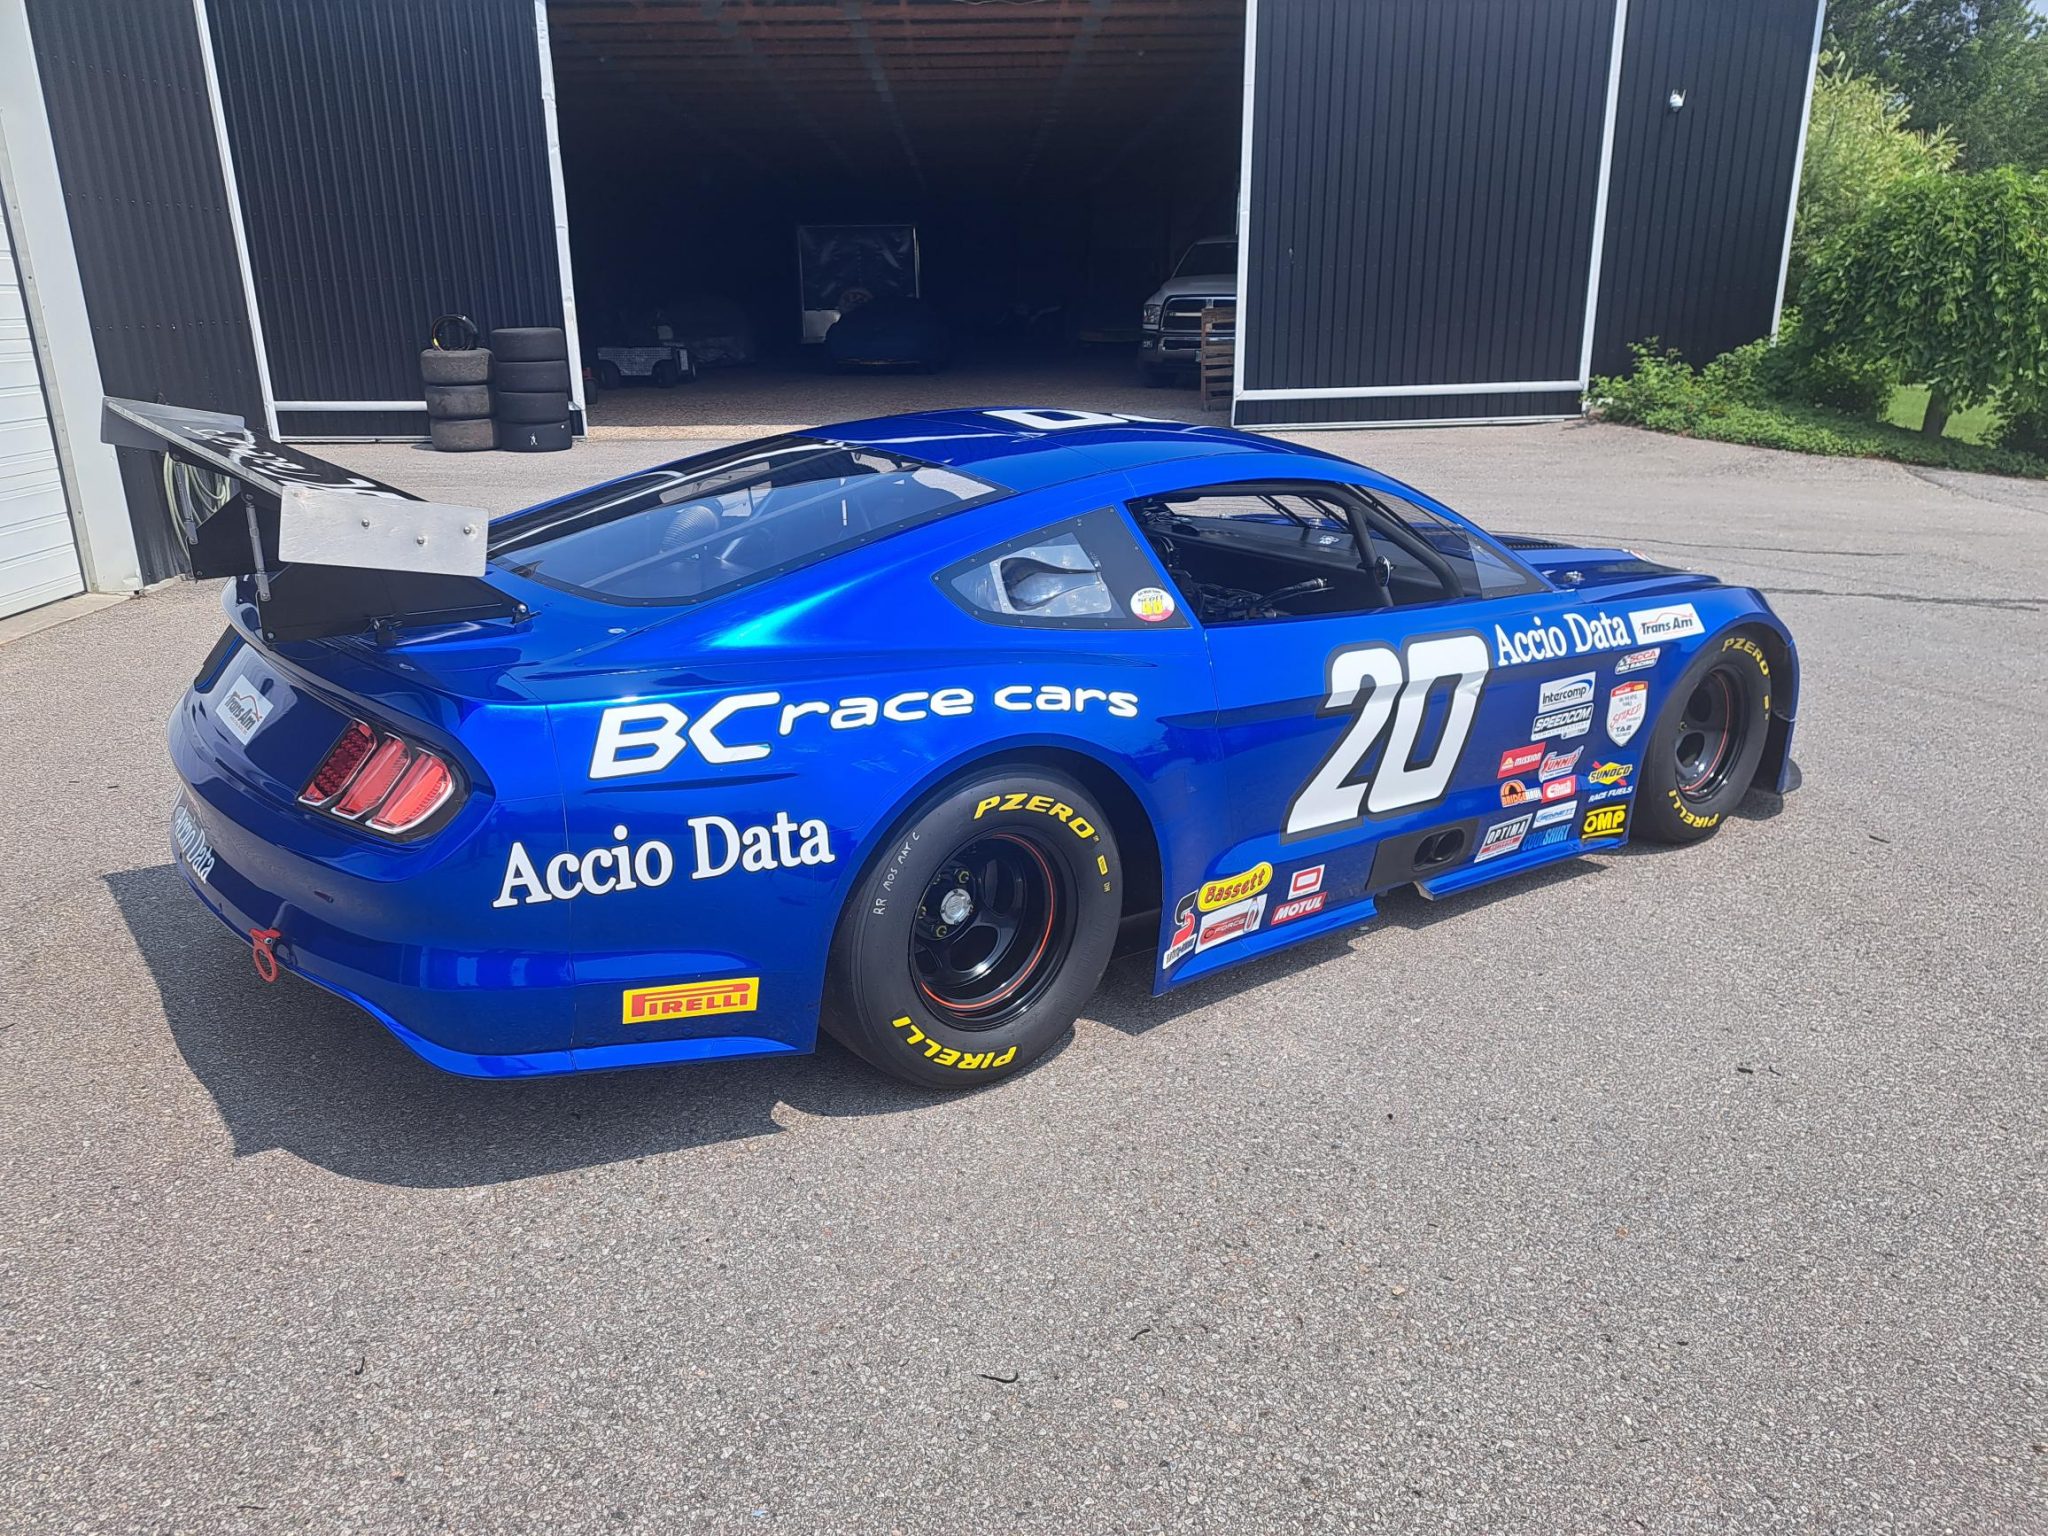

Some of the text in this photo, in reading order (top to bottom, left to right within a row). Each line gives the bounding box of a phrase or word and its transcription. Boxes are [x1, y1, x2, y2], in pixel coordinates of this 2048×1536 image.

[1494, 611, 1632, 667] Accio Data
[1641, 617, 1694, 636] Trans Am
[1722, 637, 1771, 677] PZERO
[1542, 686, 1587, 704] Intercomp
[589, 685, 1138, 779] BC race cars
[1286, 635, 1490, 834] 20
[1534, 706, 1591, 731] SPEEDCOM
[1590, 765, 1631, 781] SUNOCO
[1588, 786, 1633, 803] RACE FUELS
[1667, 789, 1719, 829] PIRELLI
[974, 793, 1096, 839] PZERO
[1486, 821, 1526, 844] OPTIMA
[1583, 810, 1626, 833] OMP
[492, 811, 836, 909] Accio Data
[1204, 868, 1266, 904] Bassett
[873, 898, 887, 915] RR
[1274, 895, 1323, 920] MOTUL
[630, 983, 751, 1018] PIRELLI
[892, 1016, 1018, 1070] PIRELLI
